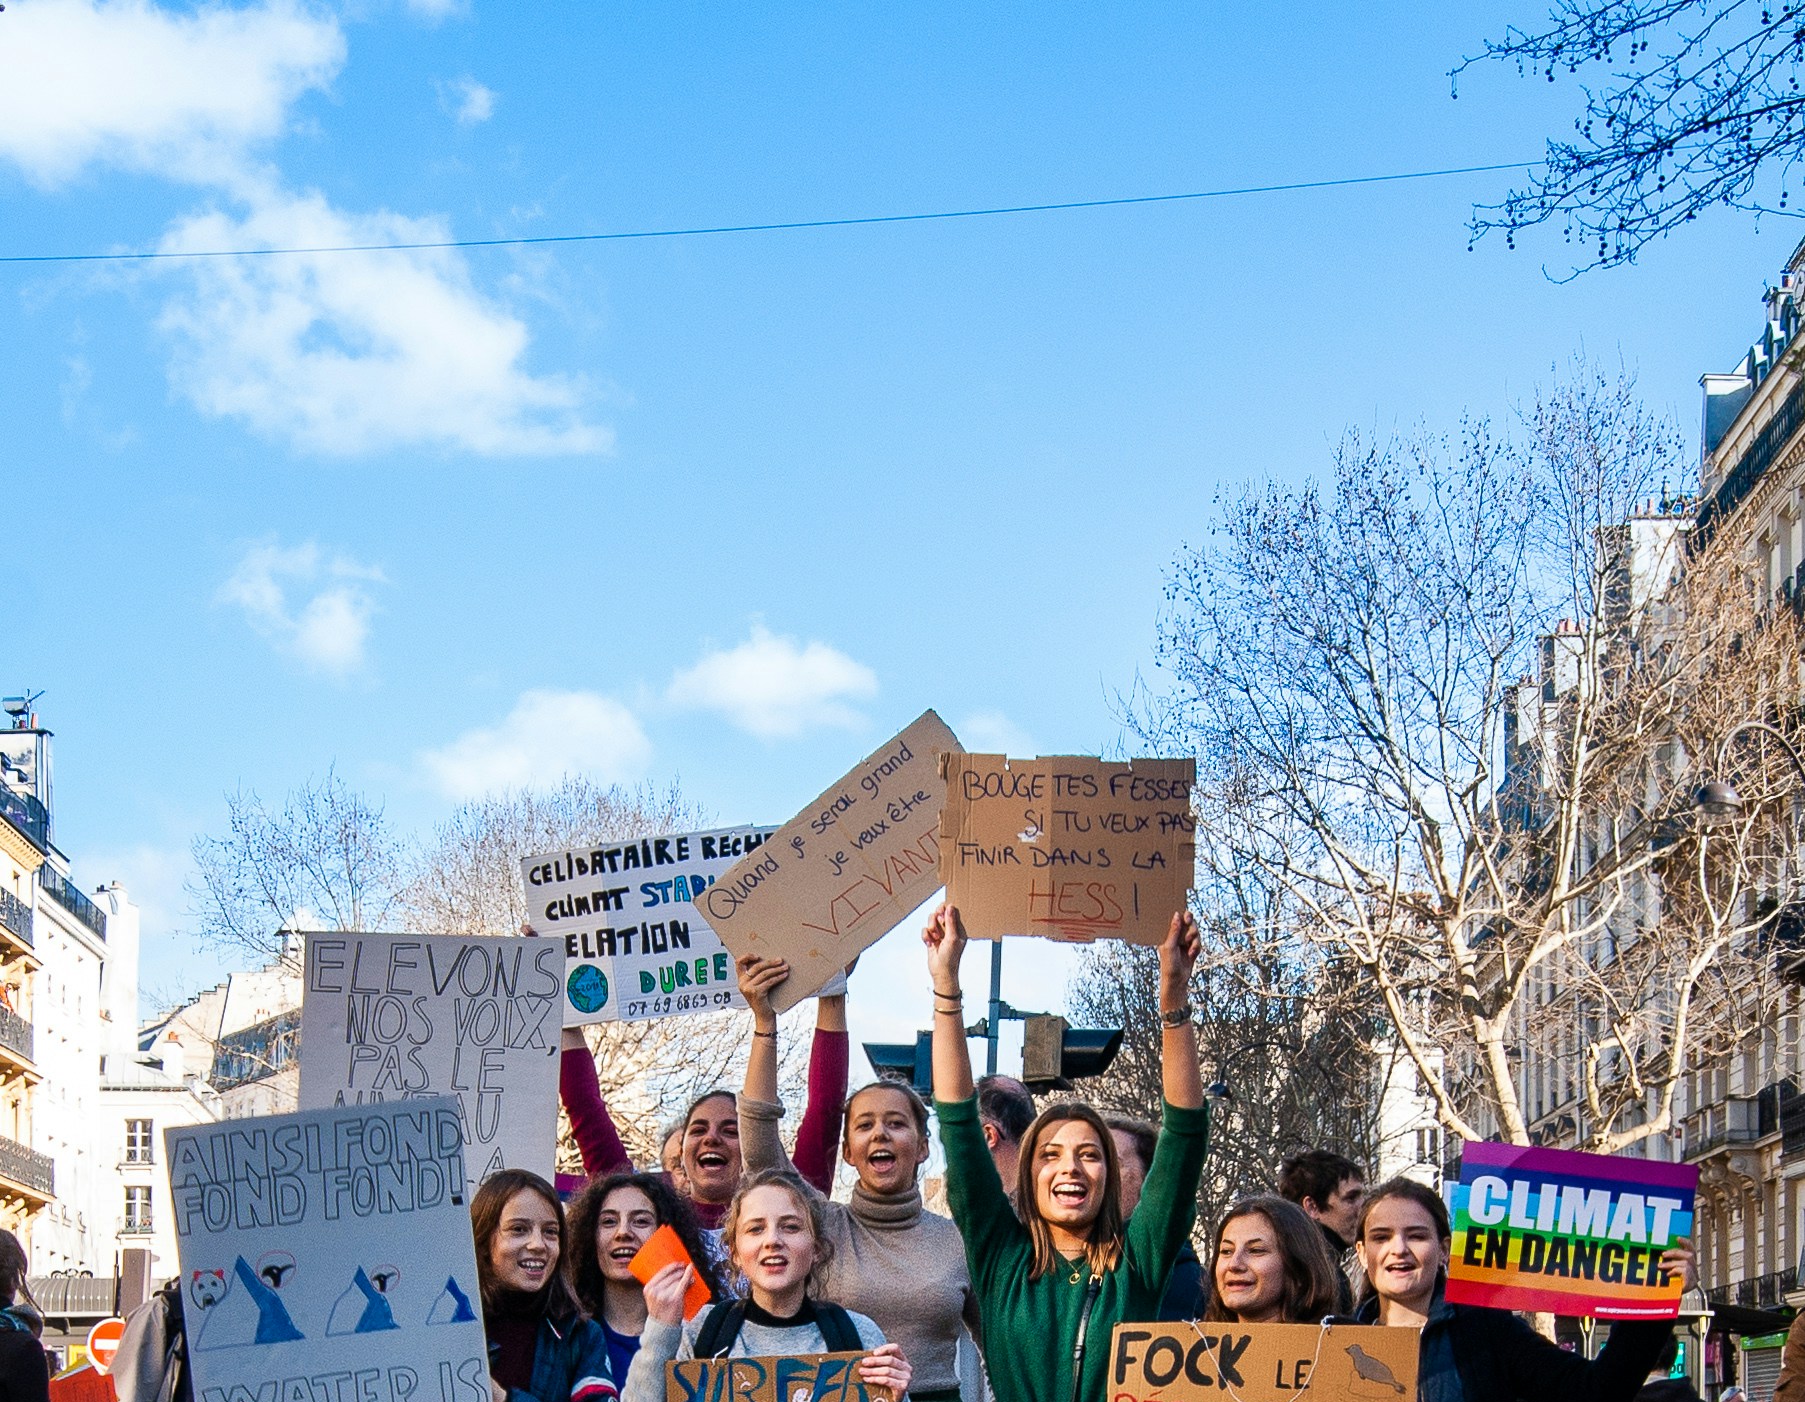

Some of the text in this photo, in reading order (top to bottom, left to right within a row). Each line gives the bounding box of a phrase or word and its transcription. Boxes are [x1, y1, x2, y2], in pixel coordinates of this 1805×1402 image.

[962, 770, 1191, 802] BOUGE TES FESSES
[700, 832, 774, 860] RECH
[708, 740, 914, 919] Quand je serai grand
[825, 788, 932, 876] je veux être
[1053, 810, 1092, 832] TU
[1099, 812, 1150, 833] VEUX
[1156, 811, 1196, 834] PAS
[1029, 847, 1111, 868] DANS
[1132, 850, 1166, 869] LA
[310, 940, 560, 998] ELEVONS
[639, 953, 728, 994] DUREE
[346, 995, 557, 1056] NOS VOIX,
[628, 1001, 648, 1016] 07
[348, 1043, 506, 1093] PAS LE
[170, 1123, 322, 1189] AINSI
[333, 1109, 463, 1168] FOND
[172, 1154, 465, 1236] FOND FOND!
[1468, 1175, 1683, 1246] CLIMAT
[1463, 1226, 1512, 1270] EN
[1114, 1331, 1313, 1390] FOCK LE
